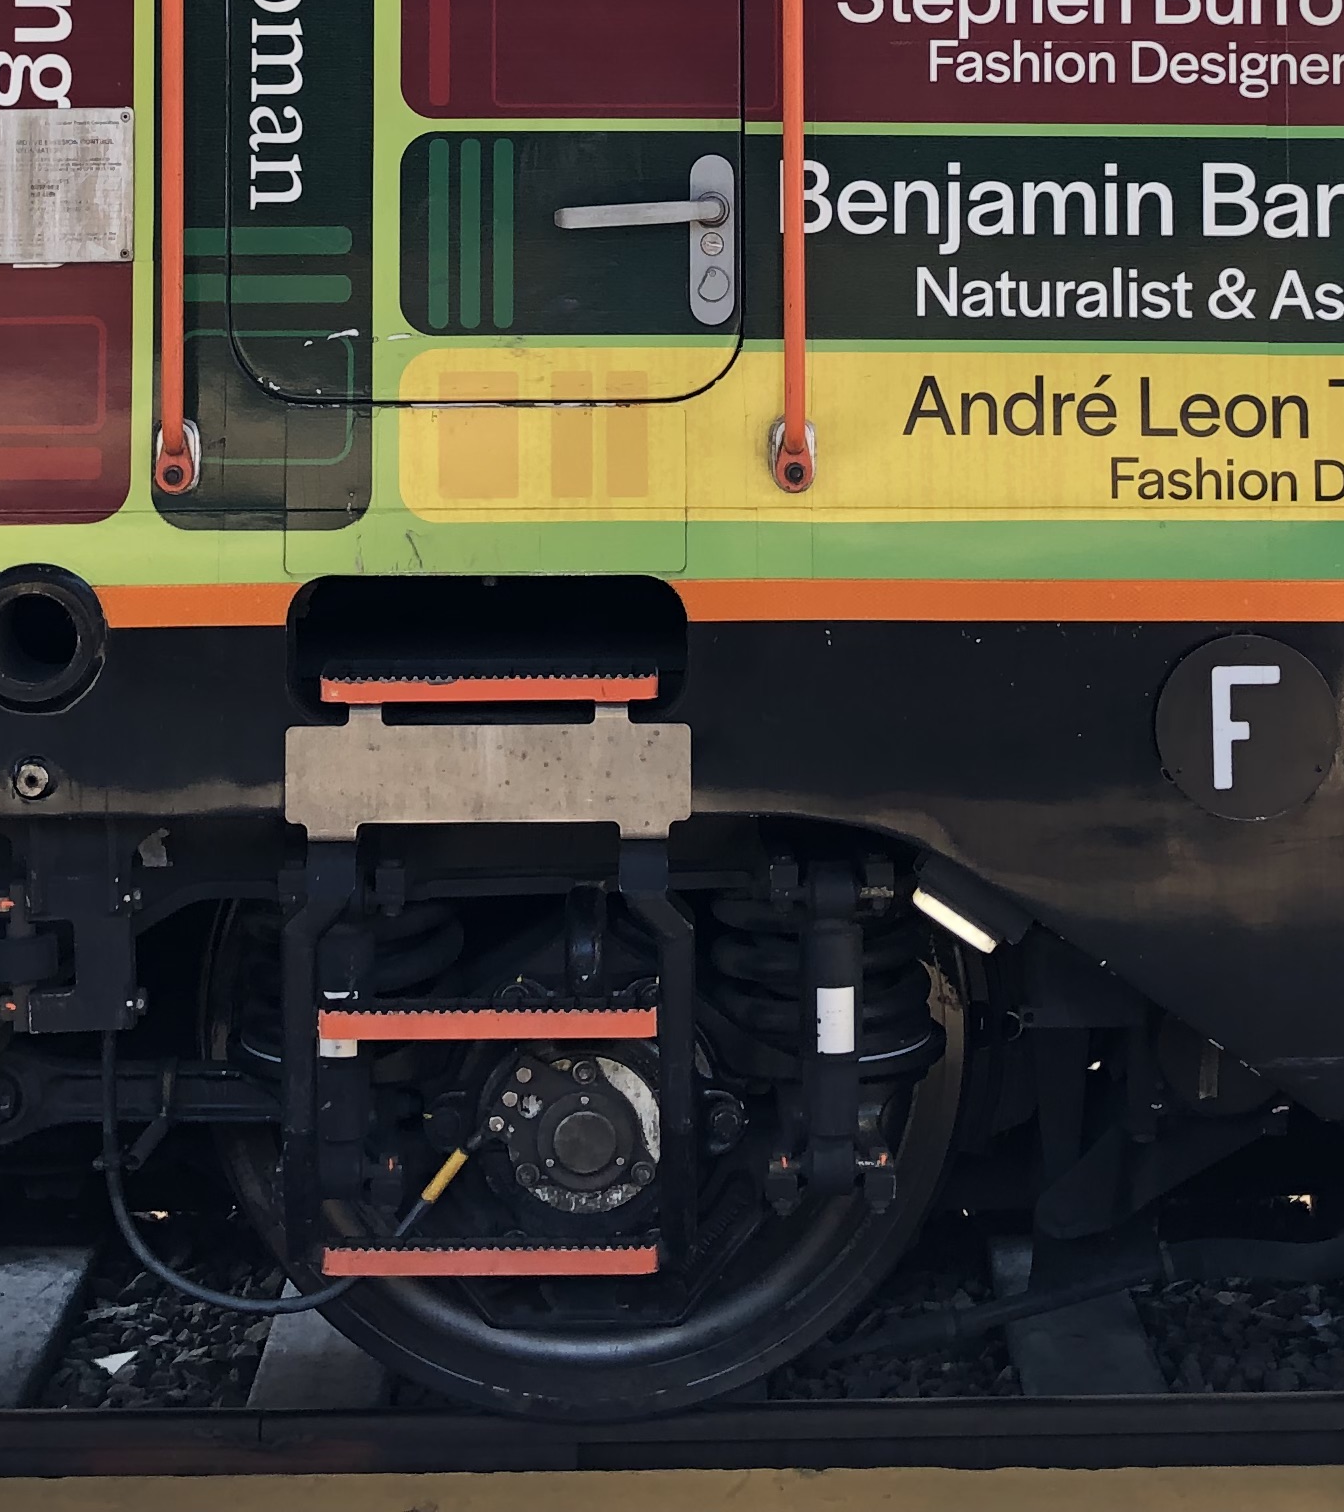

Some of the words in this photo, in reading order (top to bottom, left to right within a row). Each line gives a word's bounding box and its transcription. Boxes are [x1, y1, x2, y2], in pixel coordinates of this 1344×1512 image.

[929, 38, 1116, 84] Fashion
[779, 159, 1174, 255] Benjamin
[916, 266, 1193, 319] Naturalist
[1207, 267, 1257, 320] &
[902, 374, 1117, 437] André
[1140, 376, 1309, 439] Leon
[1110, 456, 1298, 502] Fashion
[1211, 665, 1281, 790] F
